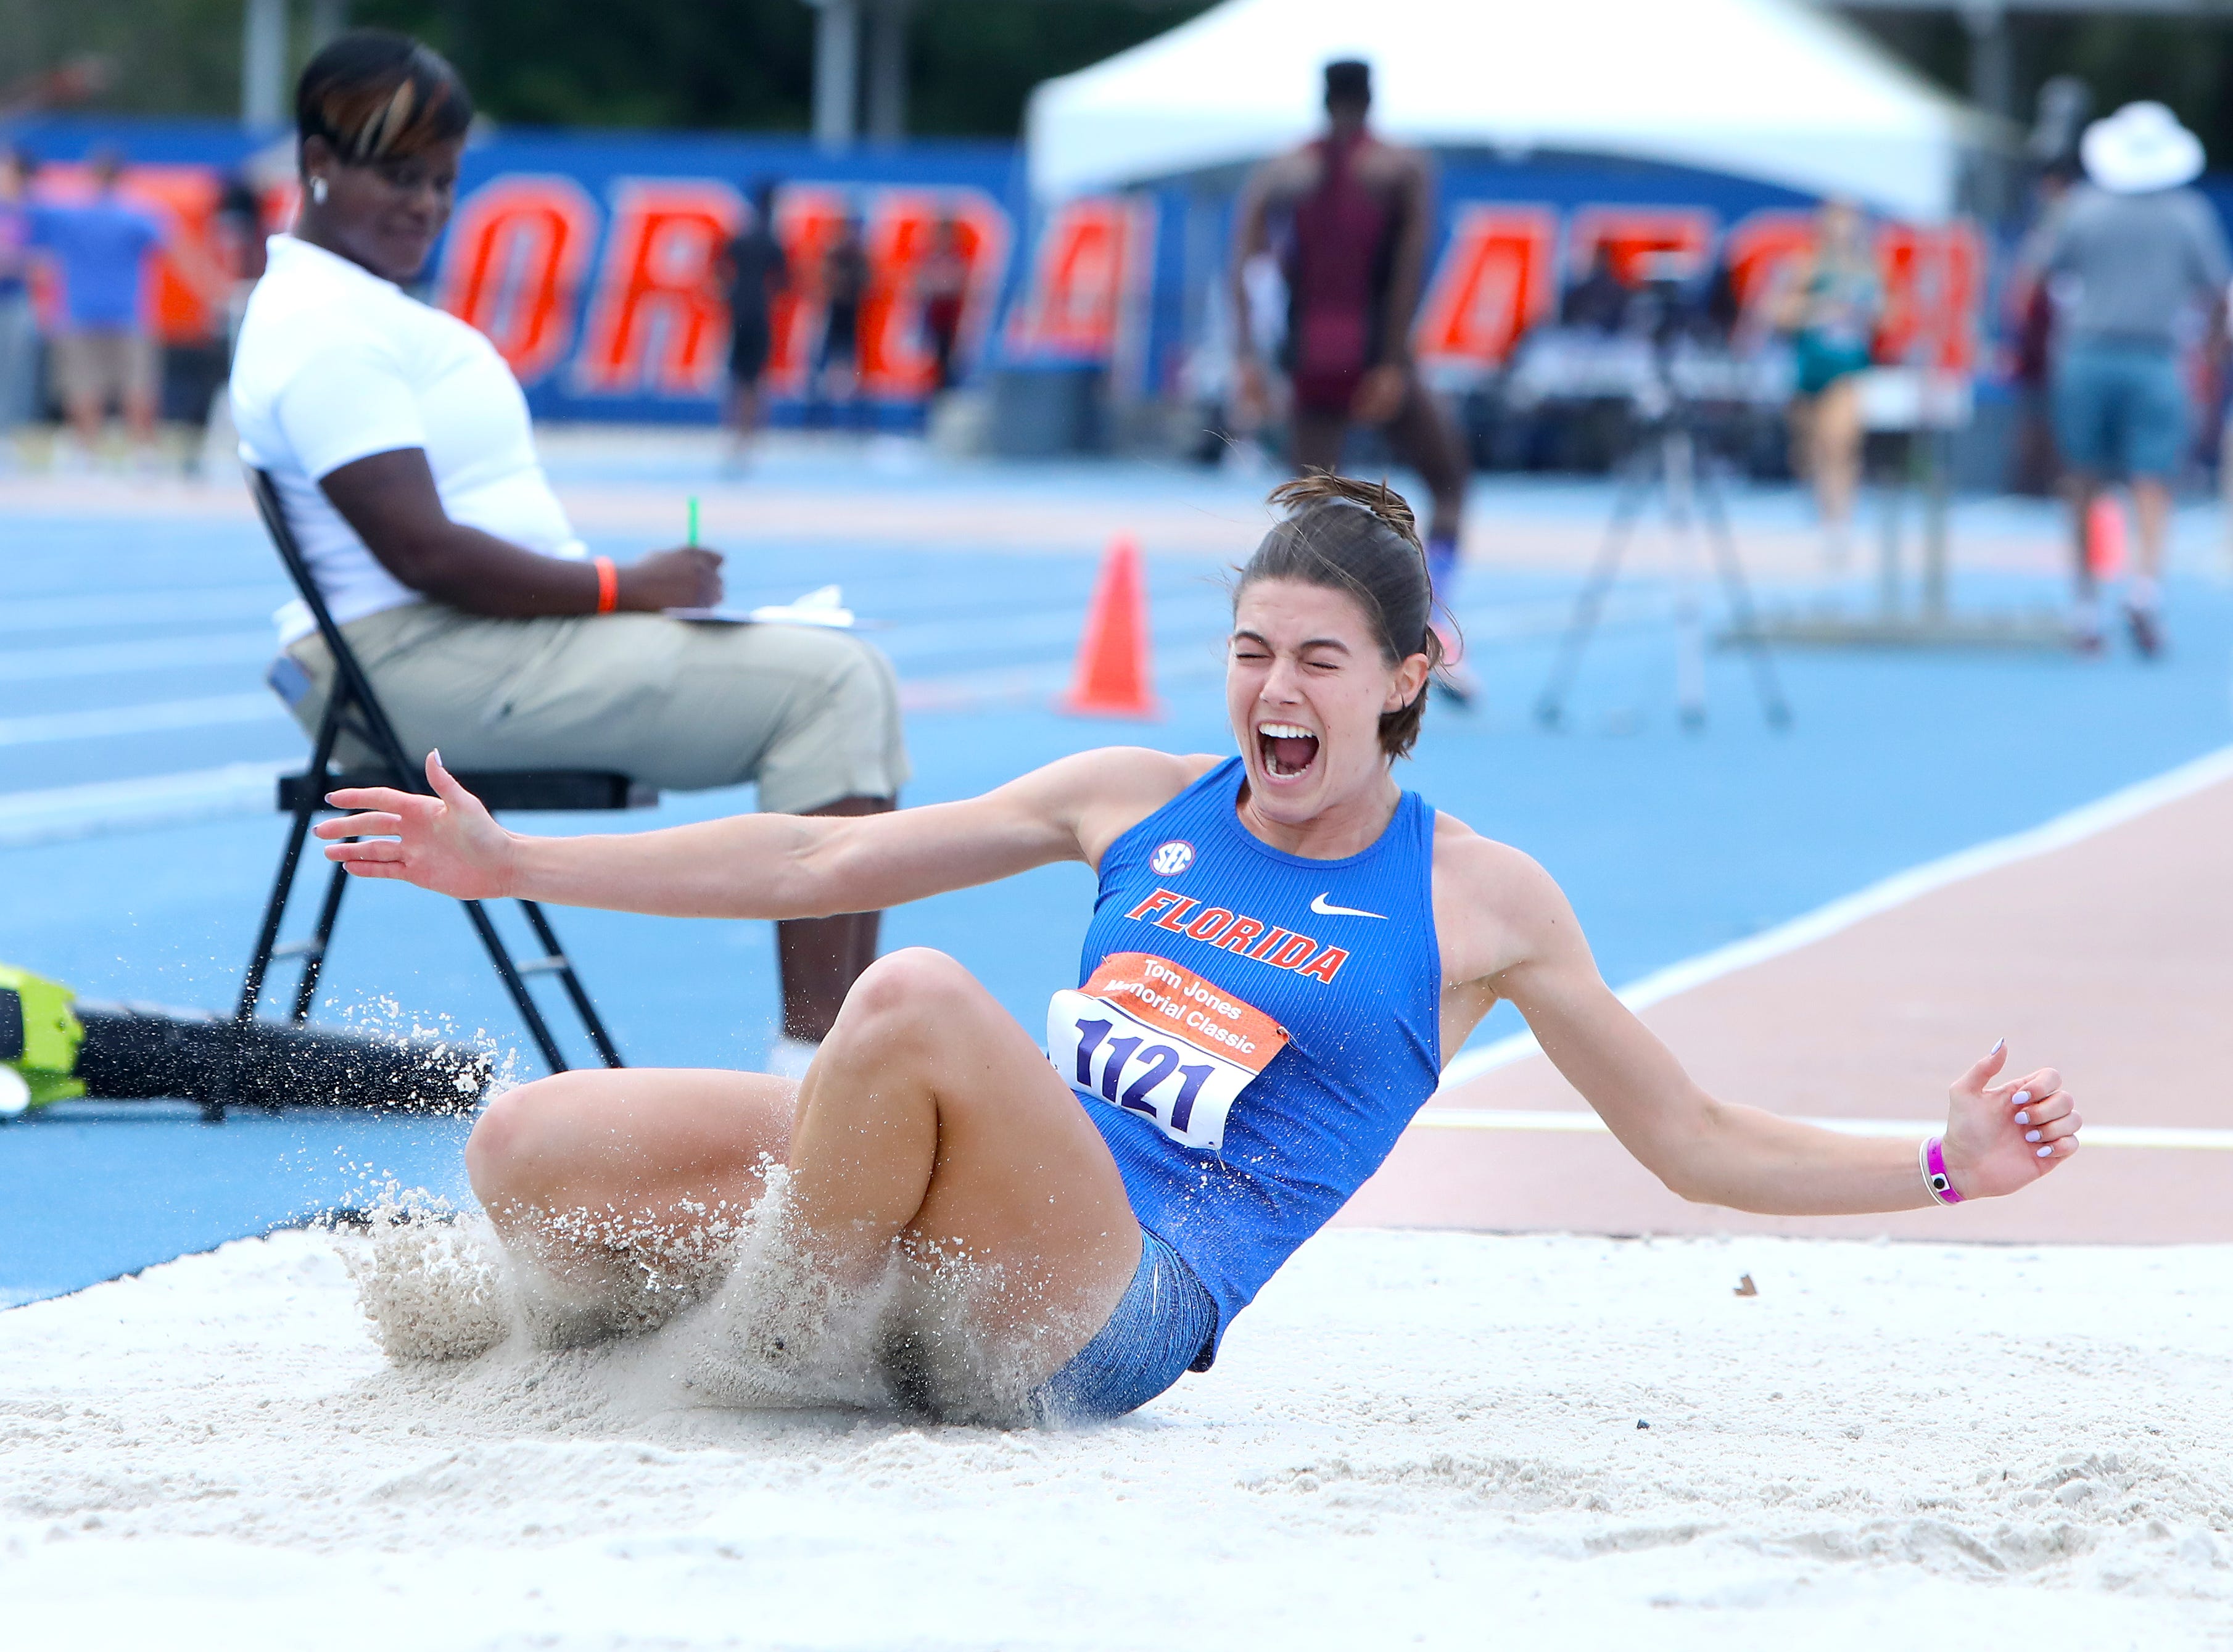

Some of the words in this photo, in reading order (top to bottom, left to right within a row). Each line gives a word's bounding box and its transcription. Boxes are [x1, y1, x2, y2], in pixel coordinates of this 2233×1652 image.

[1152, 842, 1192, 874] SEC
[1124, 887, 1350, 985] FLORIDA
[1144, 958, 1183, 989] Tom
[1183, 980, 1243, 1021] Jones
[1186, 1012, 1256, 1055] Classic
[1075, 1017, 1216, 1134] 1121
